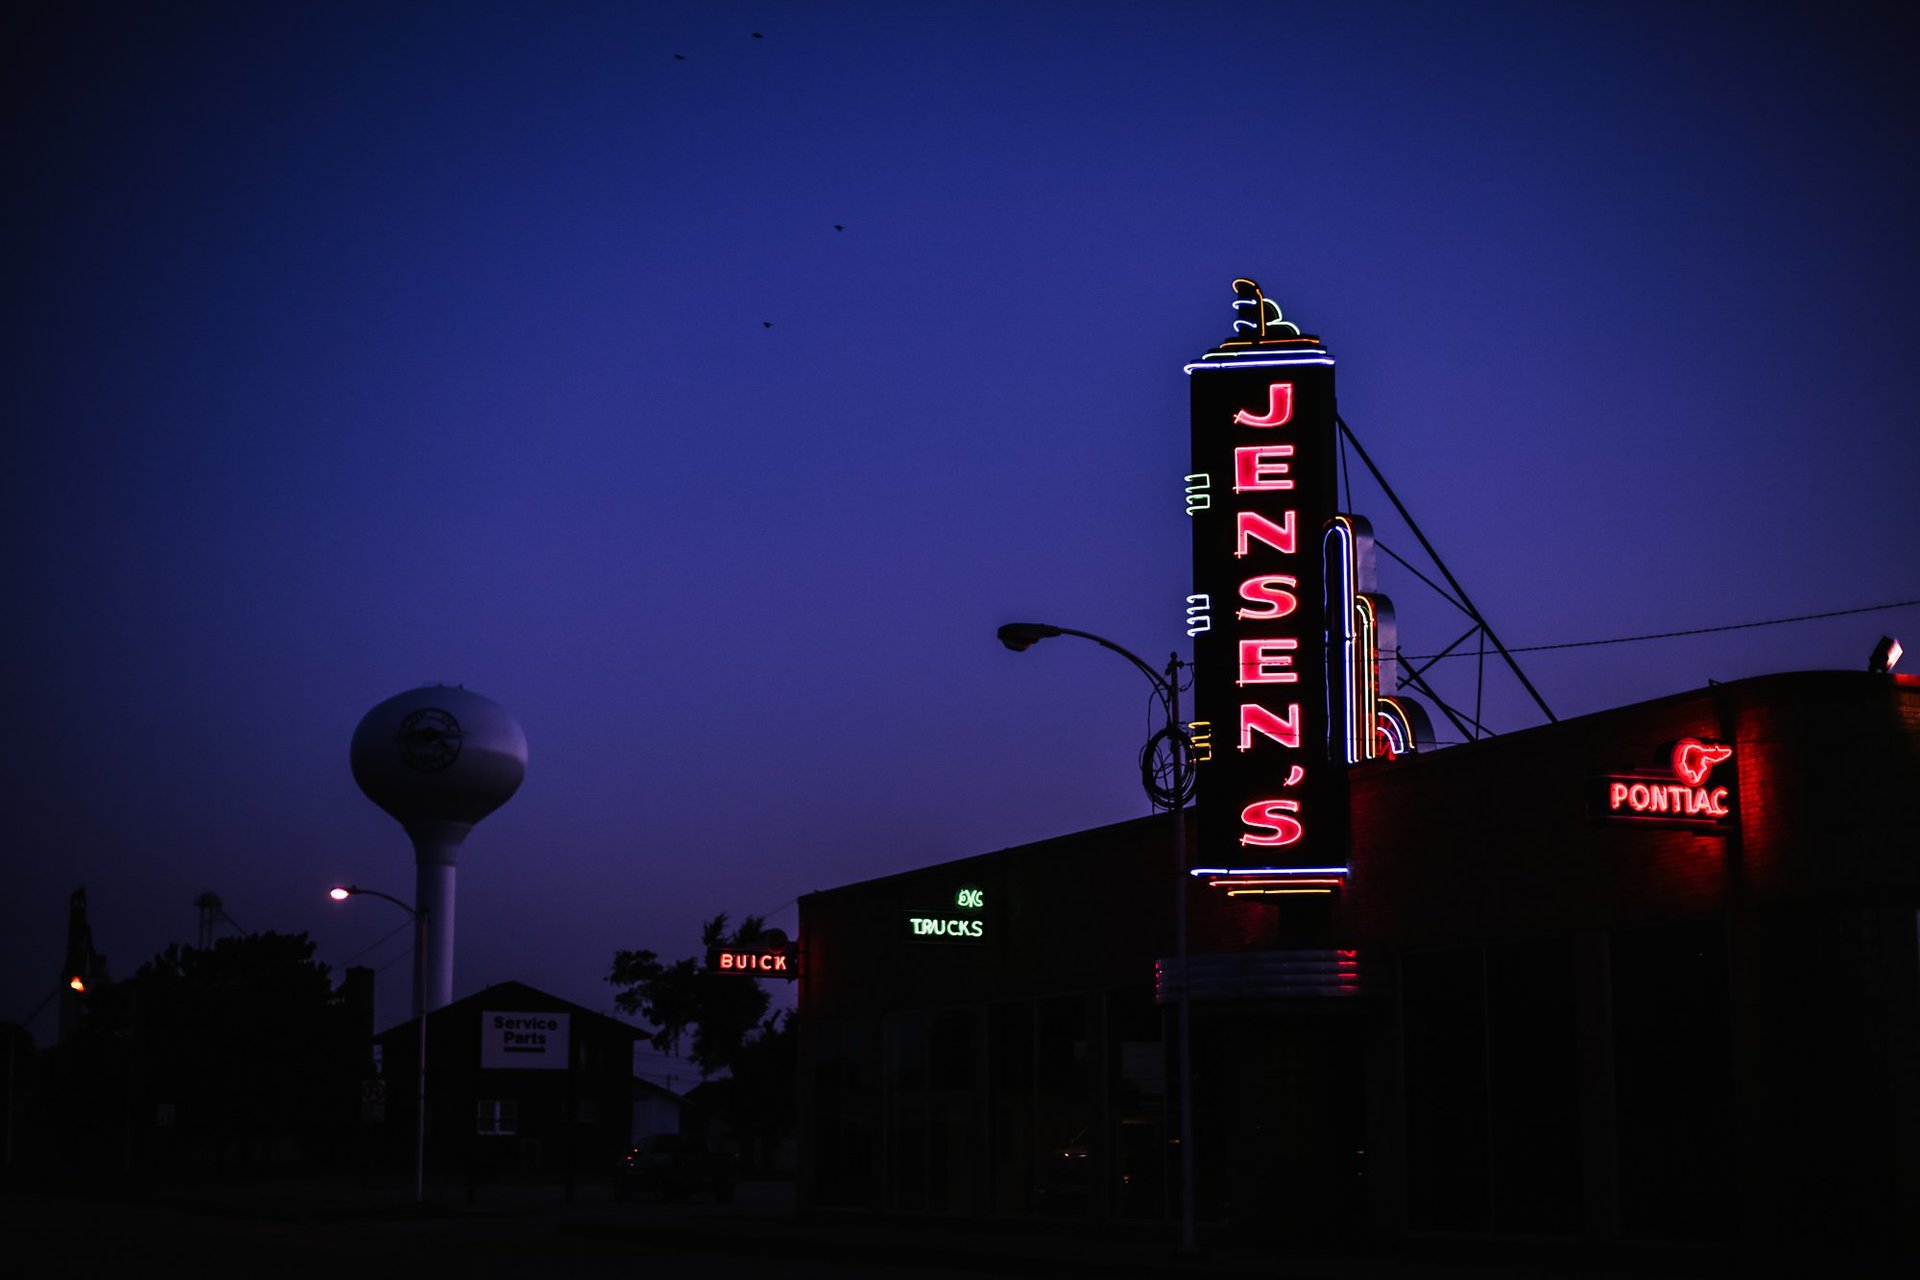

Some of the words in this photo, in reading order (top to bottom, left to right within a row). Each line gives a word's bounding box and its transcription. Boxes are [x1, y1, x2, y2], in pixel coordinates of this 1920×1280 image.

[1233, 383, 1305, 847] JENSEN'S
[1610, 782, 1729, 817] PONTIAC
[910, 918, 983, 937] TRUCKS
[720, 953, 787, 970] BUICK
[494, 1016, 558, 1031] Service
[504, 1031, 546, 1045] Parts
